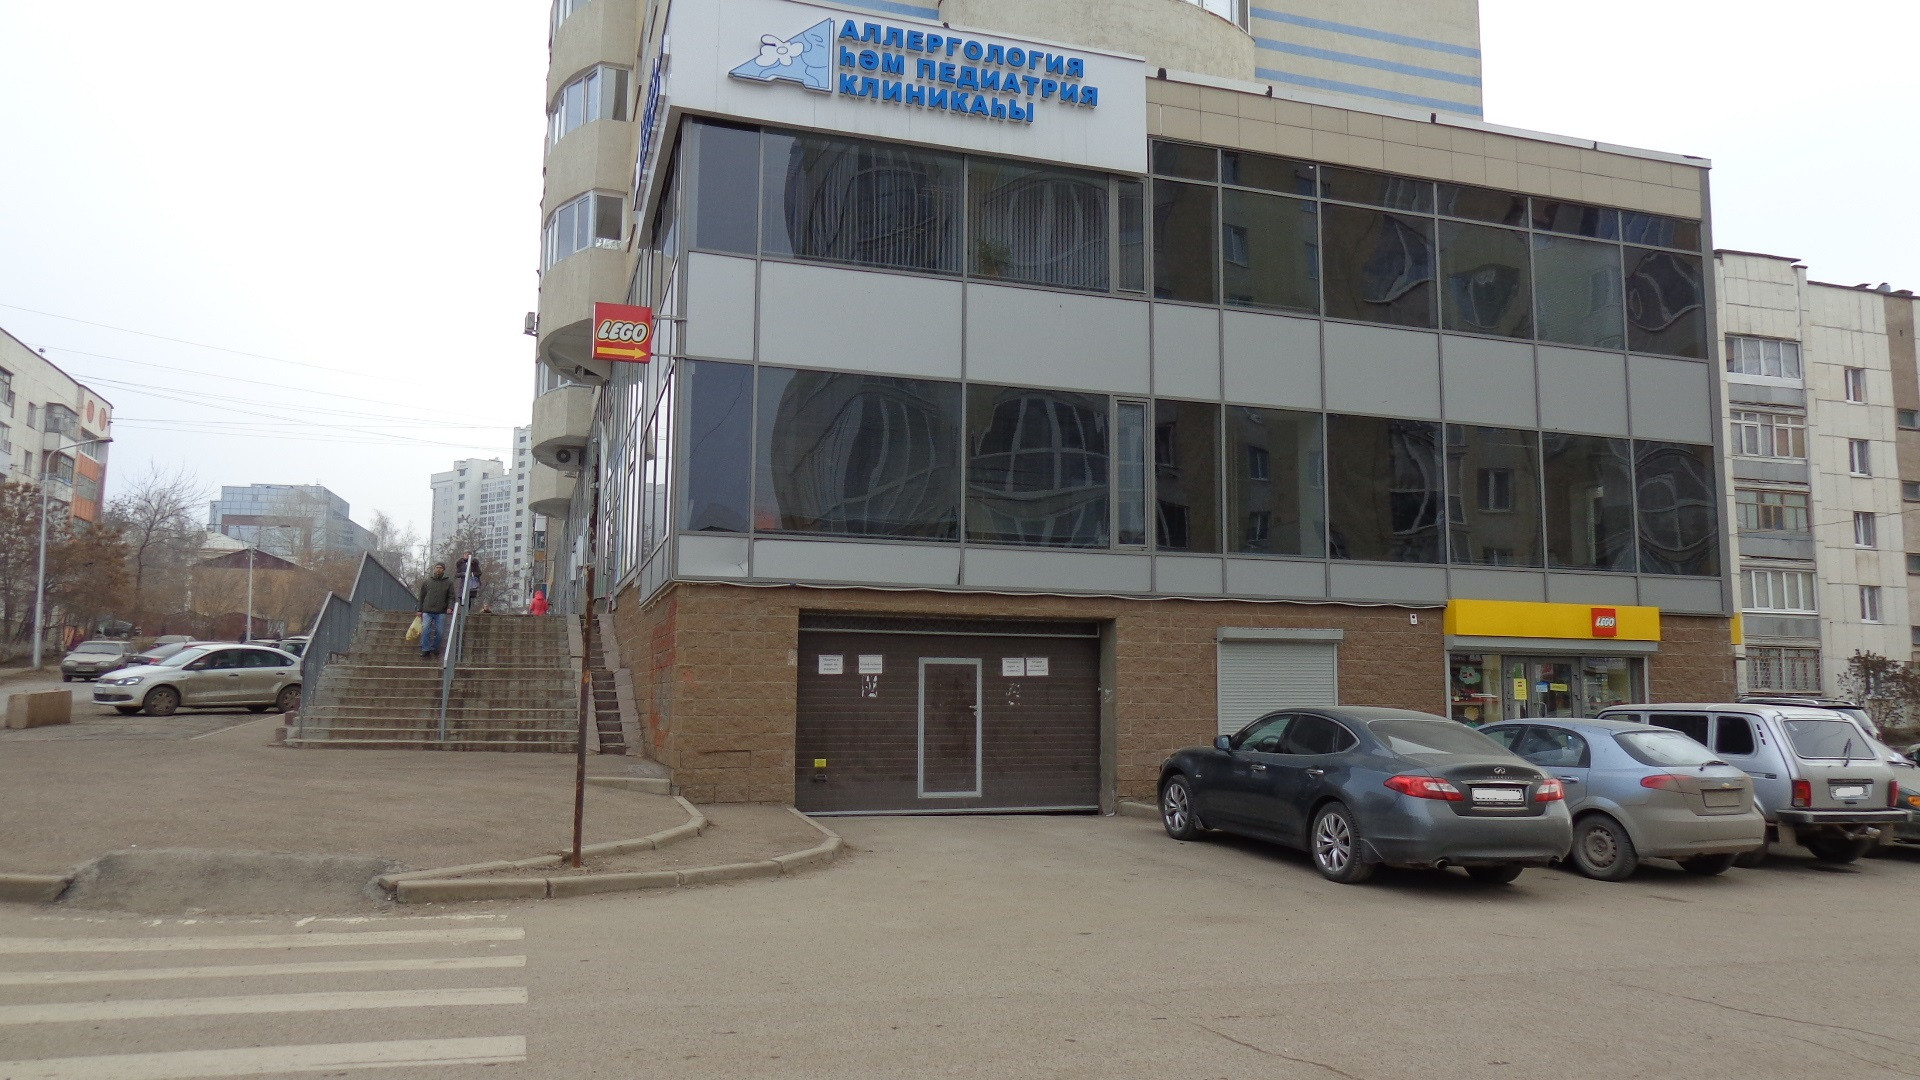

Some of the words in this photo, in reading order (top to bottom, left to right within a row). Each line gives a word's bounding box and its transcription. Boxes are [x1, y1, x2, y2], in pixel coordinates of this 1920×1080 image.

[839, 19, 1084, 78] АЛЛЕРГОЛОГИЯ
[916, 58, 1098, 107] ПЕДИАТРИЯ
[597, 319, 649, 344] LEGO
[1595, 616, 1616, 628] LEGO
